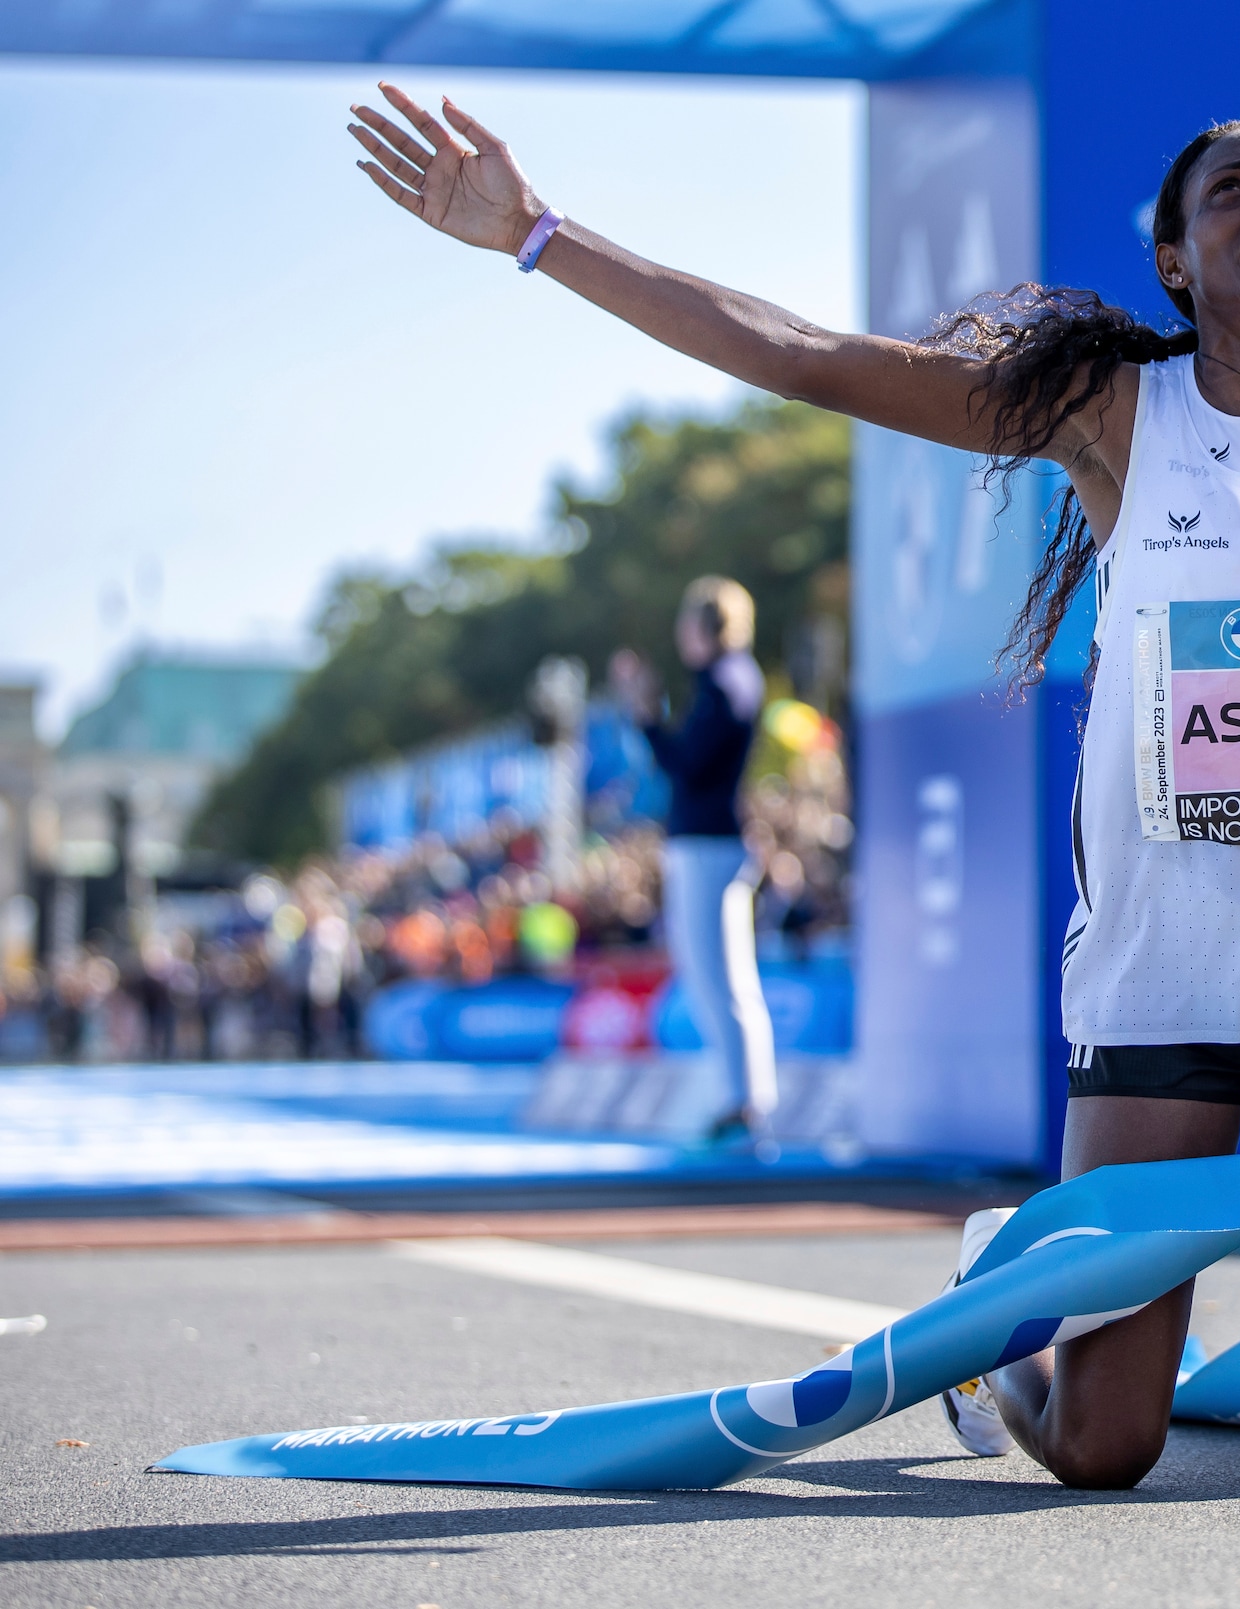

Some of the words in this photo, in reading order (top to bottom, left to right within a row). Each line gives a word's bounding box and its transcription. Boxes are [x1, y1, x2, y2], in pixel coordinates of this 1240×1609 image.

[1142, 536, 1181, 552] Tirop's
[1183, 535, 1230, 550] Angels
[1138, 629, 1152, 764] BERLI-MARATHON
[1154, 707, 1165, 737] 2023
[1142, 767, 1154, 801] BMW
[1155, 739, 1169, 802] September
[1158, 804, 1169, 820] 24.
[1182, 822, 1204, 838] IS
